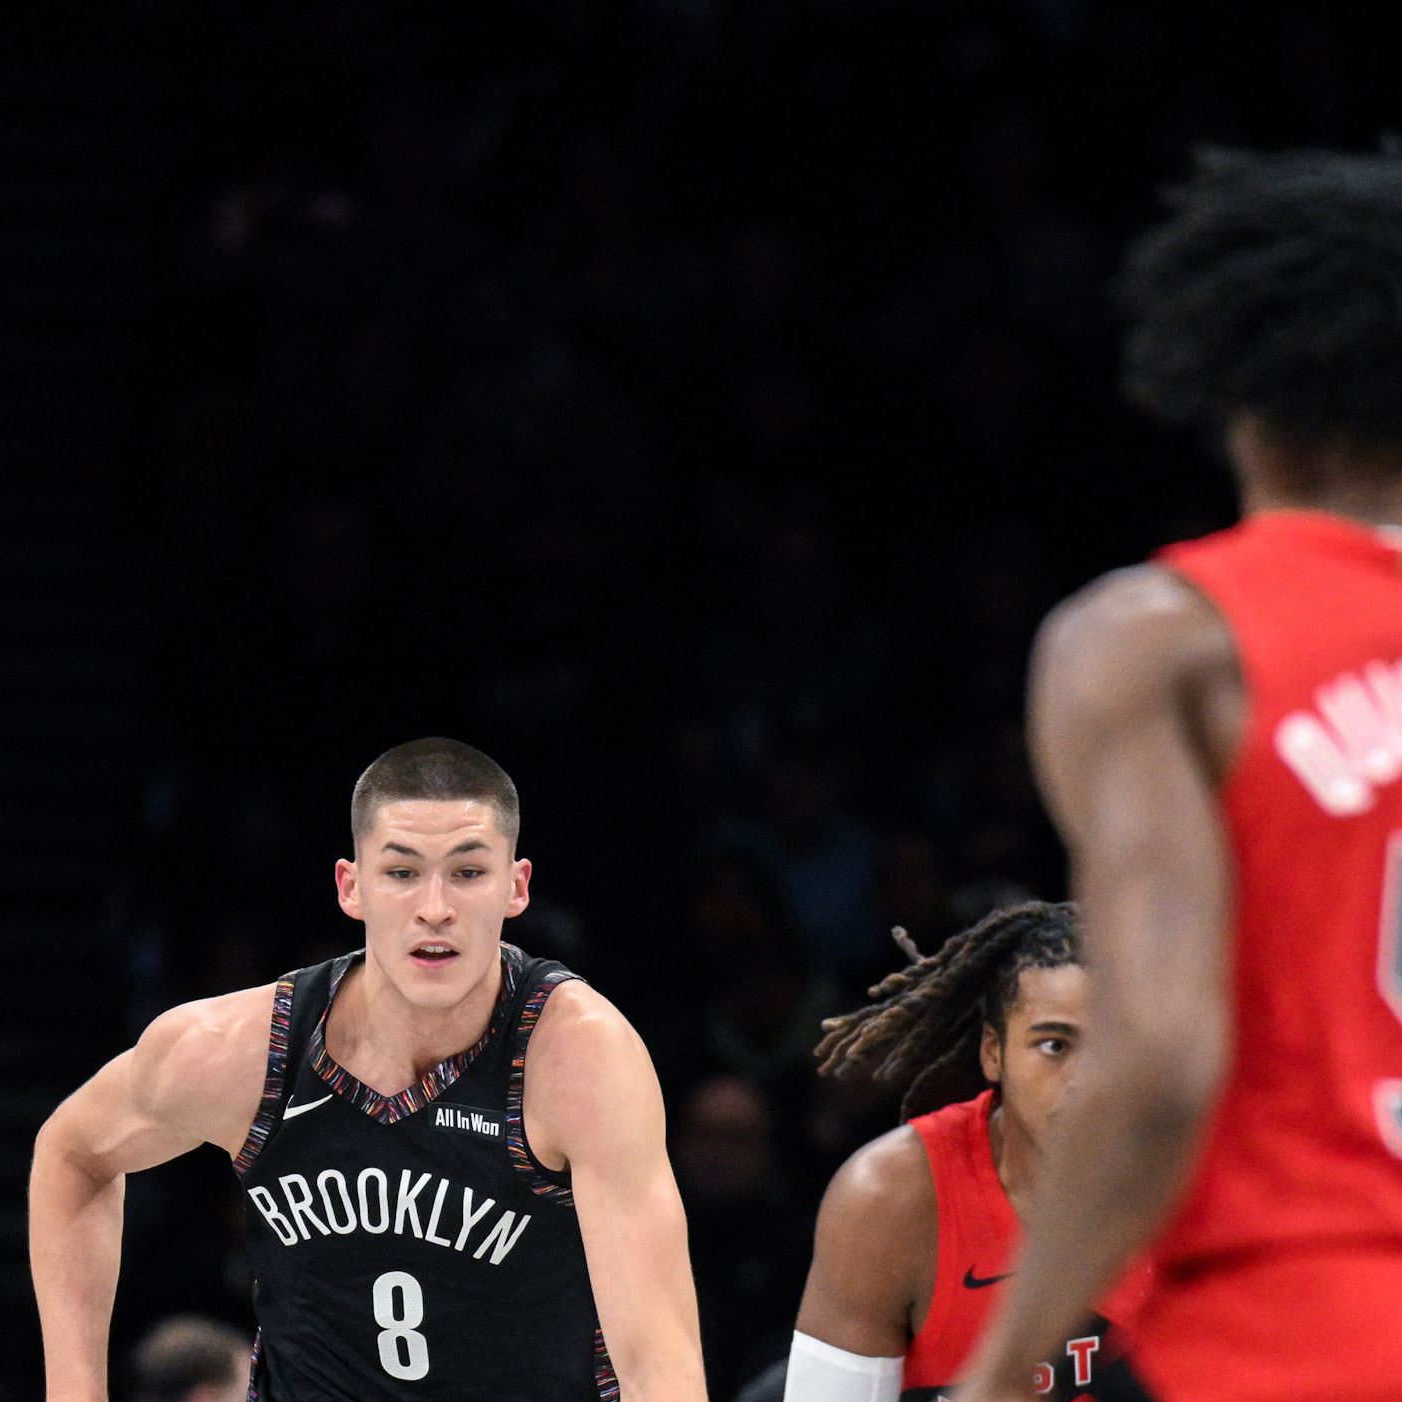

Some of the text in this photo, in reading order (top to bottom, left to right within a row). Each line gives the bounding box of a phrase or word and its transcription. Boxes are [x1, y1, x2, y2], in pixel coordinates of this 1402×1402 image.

[435, 1108, 499, 1137] All In Won
[248, 1167, 532, 1266] BROOKLYN
[372, 1271, 430, 1381] 8
